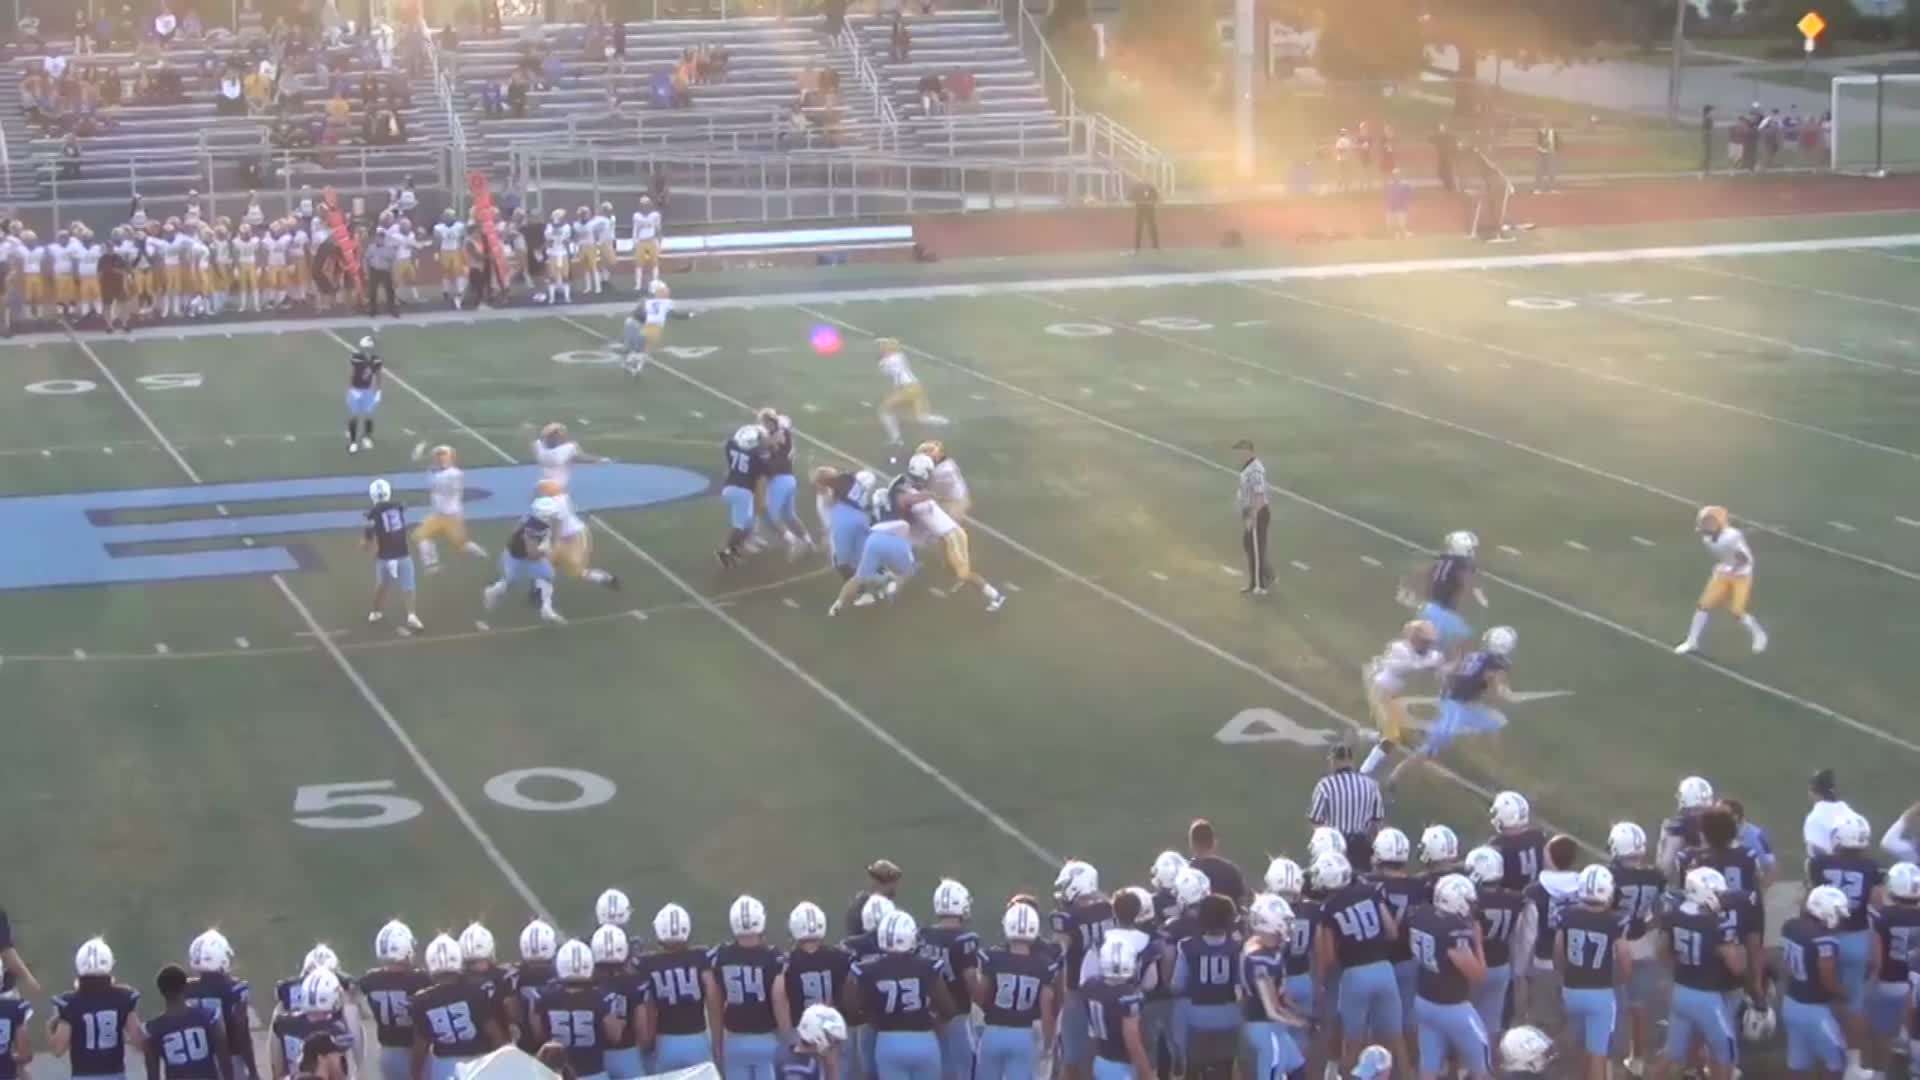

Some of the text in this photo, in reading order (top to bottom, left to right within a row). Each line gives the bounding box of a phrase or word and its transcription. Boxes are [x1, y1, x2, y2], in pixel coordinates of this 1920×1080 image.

[292, 767, 617, 828] 50
[1334, 898, 1380, 941] 40
[1567, 928, 1608, 969] 87
[651, 966, 701, 1005] 44
[1200, 955, 1230, 984] 10
[876, 978, 921, 1014] 73
[83, 1010, 118, 1050] 18
[426, 1001, 477, 1044] 93
[548, 1010, 595, 1047] 55
[162, 1027, 208, 1065] 20
